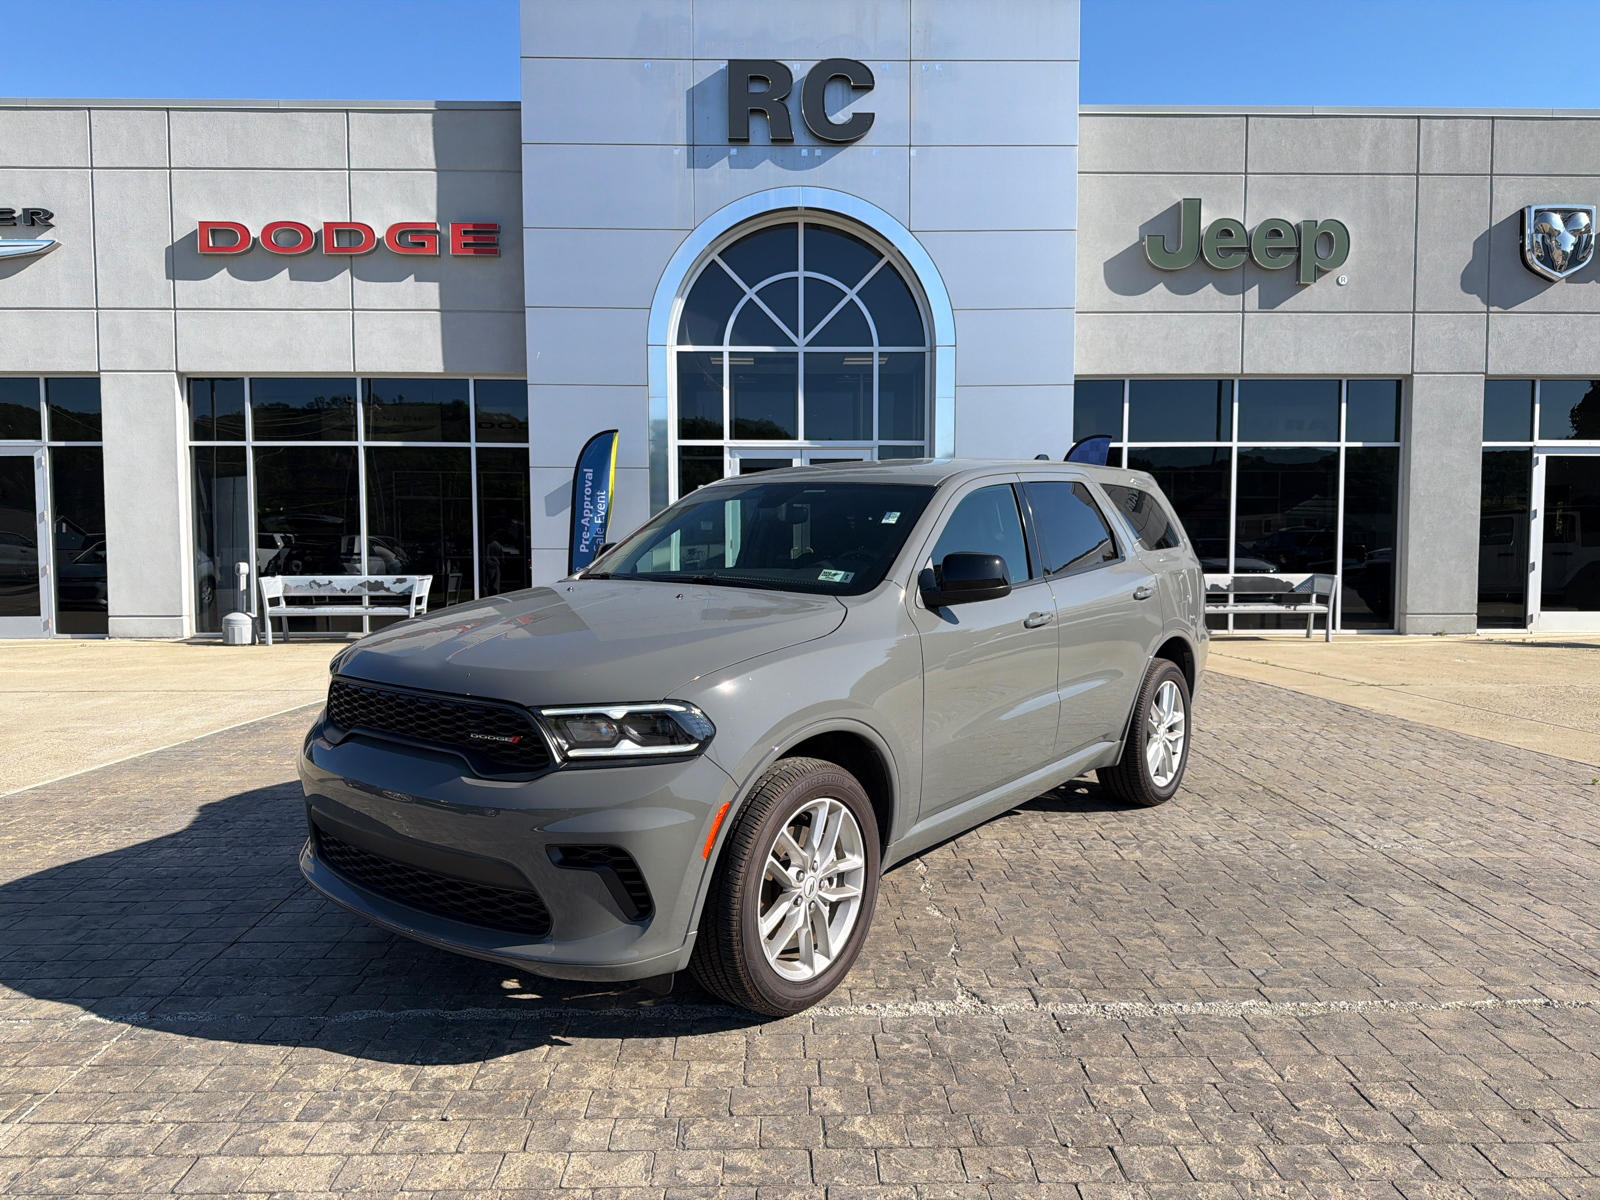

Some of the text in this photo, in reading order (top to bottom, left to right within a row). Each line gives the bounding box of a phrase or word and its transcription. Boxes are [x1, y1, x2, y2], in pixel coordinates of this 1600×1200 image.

[728, 58, 876, 143] RC
[197, 220, 500, 256] DODGE
[1144, 197, 1351, 284] Jeep
[579, 468, 594, 553] Pre-Approval
[594, 490, 606, 524] Event
[470, 733, 513, 742] DODGE
